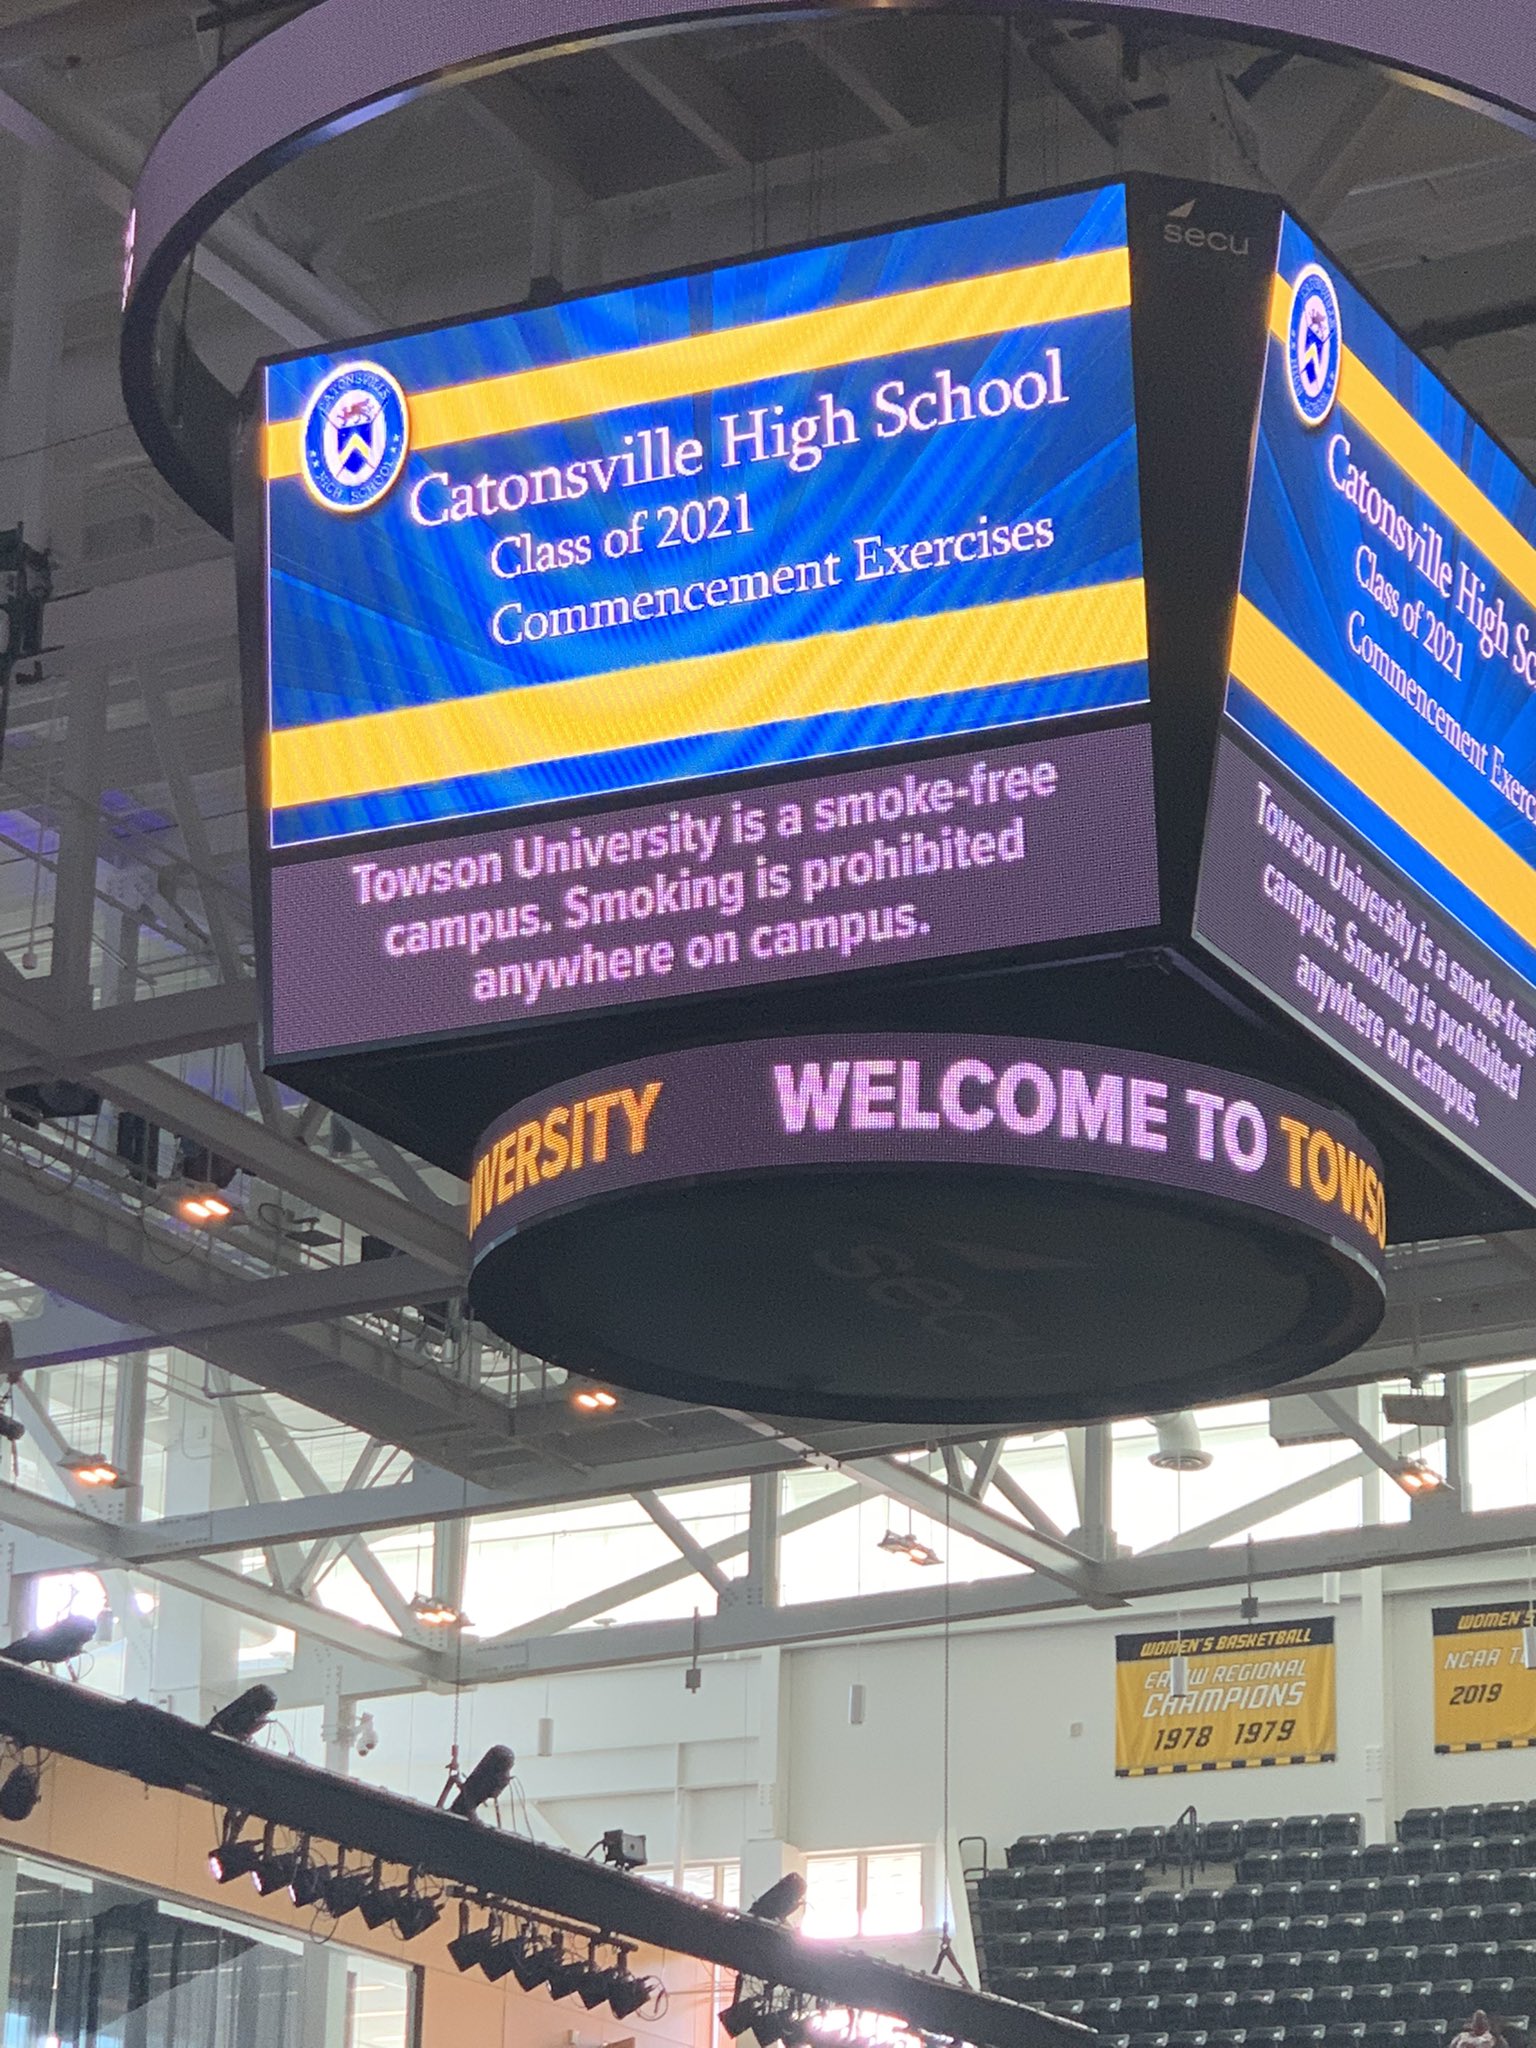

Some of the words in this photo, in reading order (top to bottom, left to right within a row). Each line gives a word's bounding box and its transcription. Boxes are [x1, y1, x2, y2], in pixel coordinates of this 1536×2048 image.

[1163, 224, 1248, 255] secu
[409, 427, 703, 527] Catonsville
[720, 394, 860, 473] High
[875, 348, 1070, 438] School
[491, 534, 591, 579] Class
[605, 510, 648, 558] of
[657, 493, 754, 548] 2021
[493, 554, 841, 645] Commencement
[854, 518, 1054, 581] Exercises
[1328, 434, 1453, 598] Catonsville
[1455, 560, 1510, 659] High
[1356, 545, 1400, 618] Class
[1402, 600, 1425, 639] of
[1423, 610, 1464, 682] 2021
[1348, 610, 1489, 776] Commencement
[352, 852, 502, 904] Towson
[513, 810, 722, 879] University
[731, 800, 766, 843] is
[777, 802, 802, 838] a
[814, 761, 1058, 832] smoke-free
[385, 903, 552, 957] campus.
[564, 867, 745, 929] Smoking
[756, 855, 791, 899] is
[802, 816, 1026, 904] prohibited
[474, 941, 675, 1006] anywhere
[686, 931, 740, 969] on
[752, 904, 931, 958] campus.
[1258, 781, 1327, 877] Towson
[1330, 845, 1418, 961] University
[1417, 921, 1434, 969] is
[1435, 948, 1448, 980] a
[1449, 960, 1536, 1058] smoke-free
[1264, 863, 1340, 952] campus.
[1343, 920, 1420, 1026] Smoking
[1420, 982, 1437, 1031] is
[1437, 1008, 1521, 1100] prohibited
[1297, 954, 1385, 1048] anywhere
[1386, 1027, 1410, 1069] on
[1413, 1048, 1480, 1126] campus.
[773, 1058, 1169, 1153] WELCOME
[1185, 1089, 1268, 1173] TO
[1280, 1115, 1386, 1250] TOWSO
[1140, 1635, 1215, 1658] WOMEN'S
[1215, 1627, 1312, 1651] BASKETBALL
[1143, 1681, 1307, 1718] CHAMPIONS
[1144, 1666, 1209, 1690] EAW
[1212, 1659, 1306, 1684] REGIONAL
[1444, 1647, 1503, 1670] NCAA
[1449, 1682, 1503, 1705] 2019
[1155, 1724, 1214, 1751] 1978
[1234, 1718, 1296, 1746] 1979
